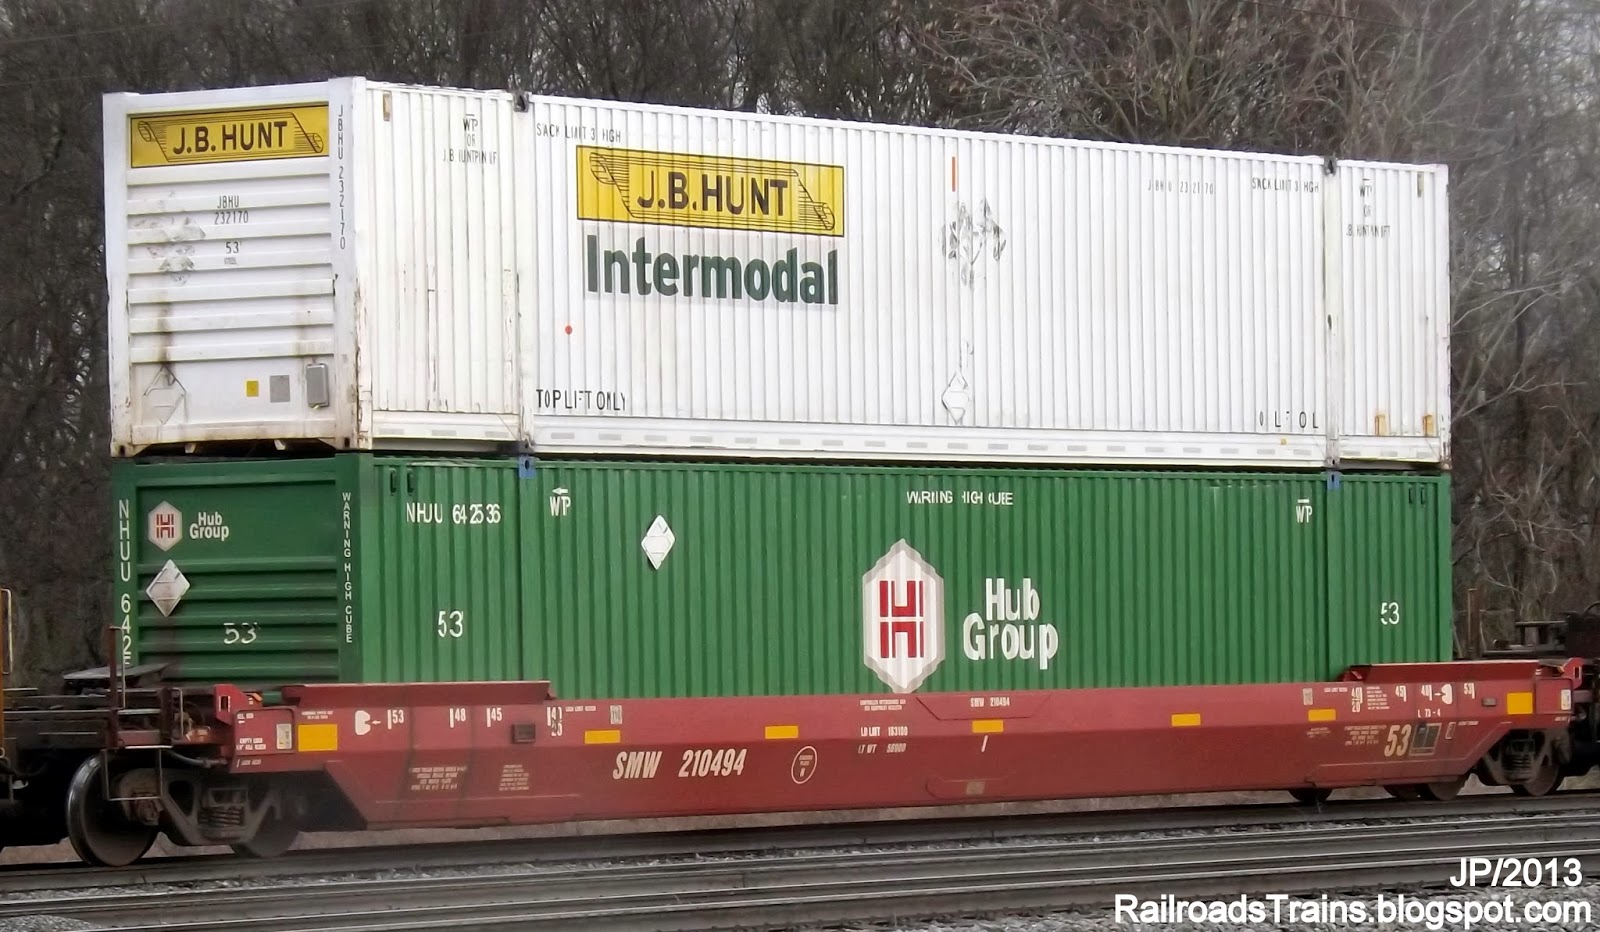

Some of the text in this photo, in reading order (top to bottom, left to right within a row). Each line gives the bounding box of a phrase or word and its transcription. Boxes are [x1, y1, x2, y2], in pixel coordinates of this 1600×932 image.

[337, 104, 346, 250] JBHU 232170
[217, 195, 239, 208] JBHU
[214, 210, 249, 225] 232170
[586, 234, 839, 305] Intermodal
[536, 389, 562, 409] TOP
[596, 391, 626, 411] ONLY
[197, 511, 222, 526] Hub
[452, 503, 501, 525] 642536
[118, 499, 131, 582] NHUU
[189, 523, 230, 541] Group
[342, 492, 353, 643] WARNING HIGH CUBE
[985, 577, 1040, 621] Hub
[963, 612, 1059, 670] Group
[392, 709, 404, 724] 53
[454, 708, 466, 722] 48
[491, 707, 503, 722] 45
[1384, 723, 1412, 757] 53
[612, 748, 748, 780] SMW 210494
